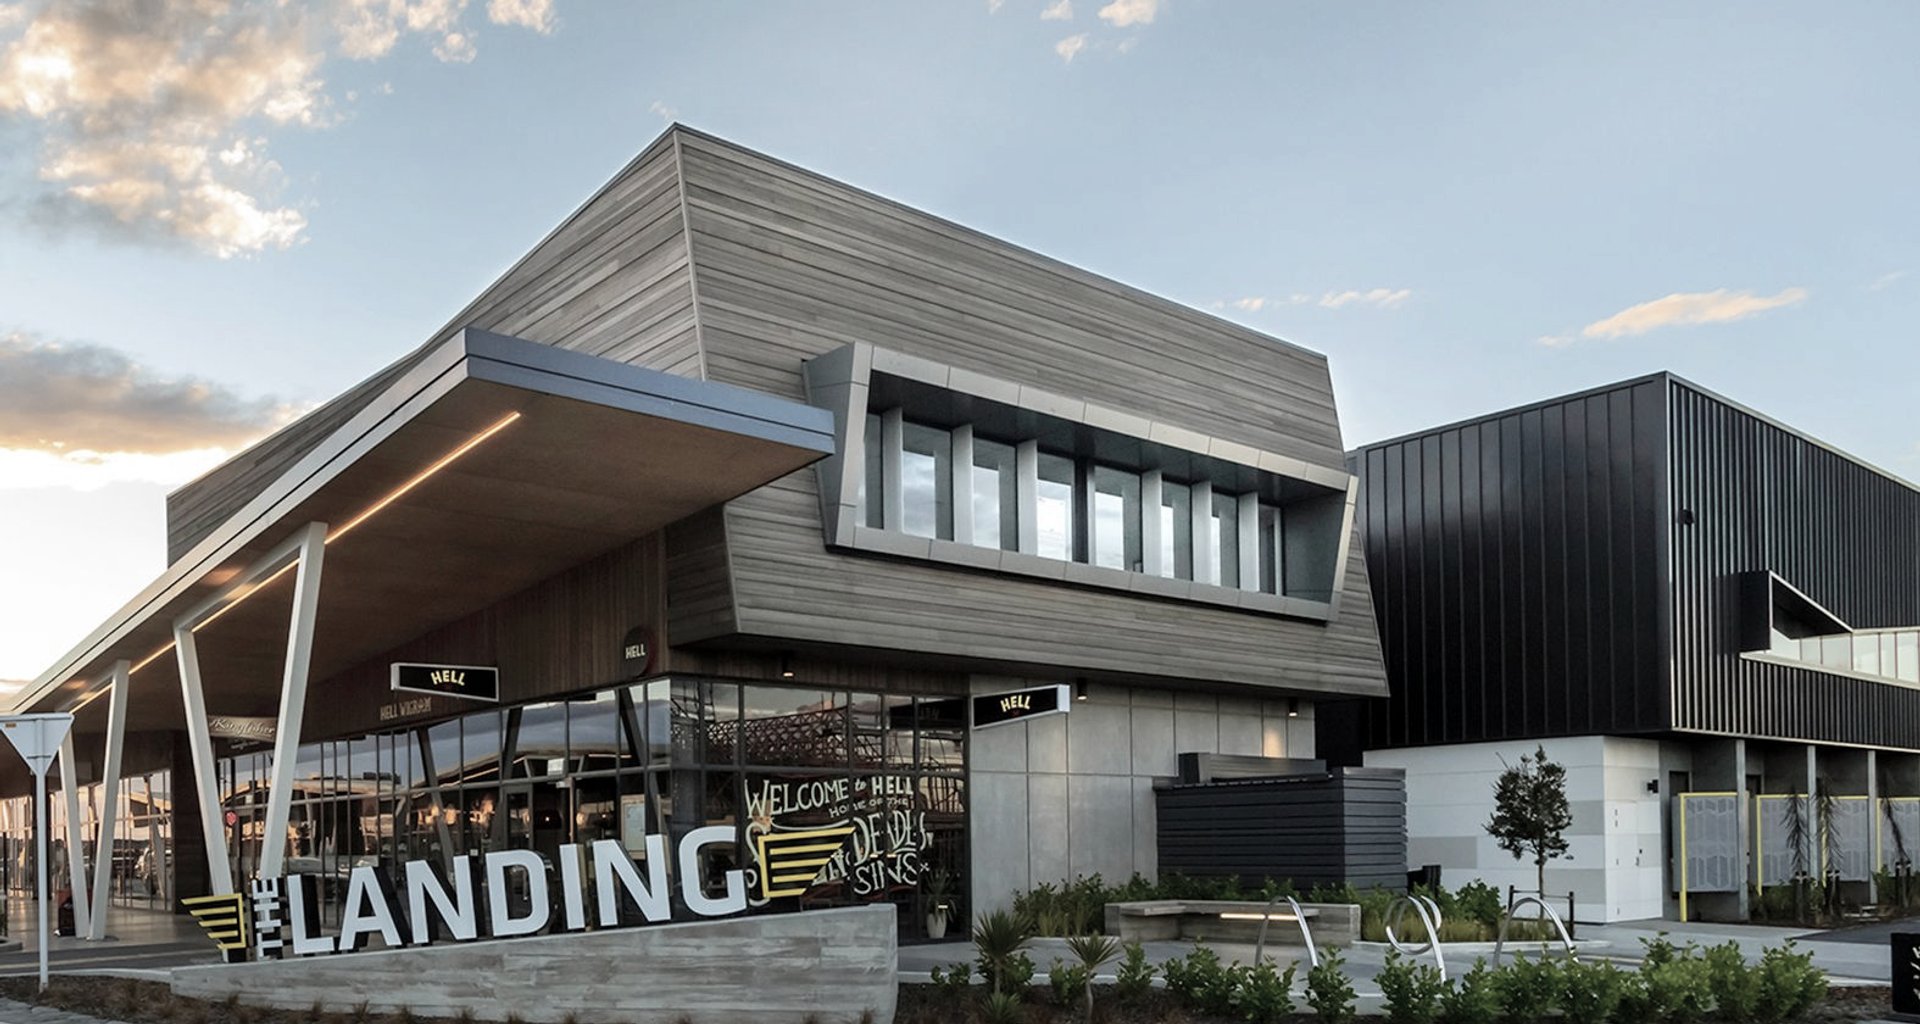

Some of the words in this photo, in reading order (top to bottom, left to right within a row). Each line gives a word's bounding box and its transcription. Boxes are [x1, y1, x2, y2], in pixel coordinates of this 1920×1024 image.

[625, 644, 646, 659] HELL
[430, 670, 465, 686] HELL
[380, 703, 398, 720] HELL
[1000, 695, 1031, 712] HELL
[744, 778, 849, 818] WELCOME
[855, 779, 867, 792] to
[871, 776, 914, 795] HELL
[854, 852, 918, 895] SINS
[251, 876, 284, 959] THE
[287, 825, 748, 956] LANDING
